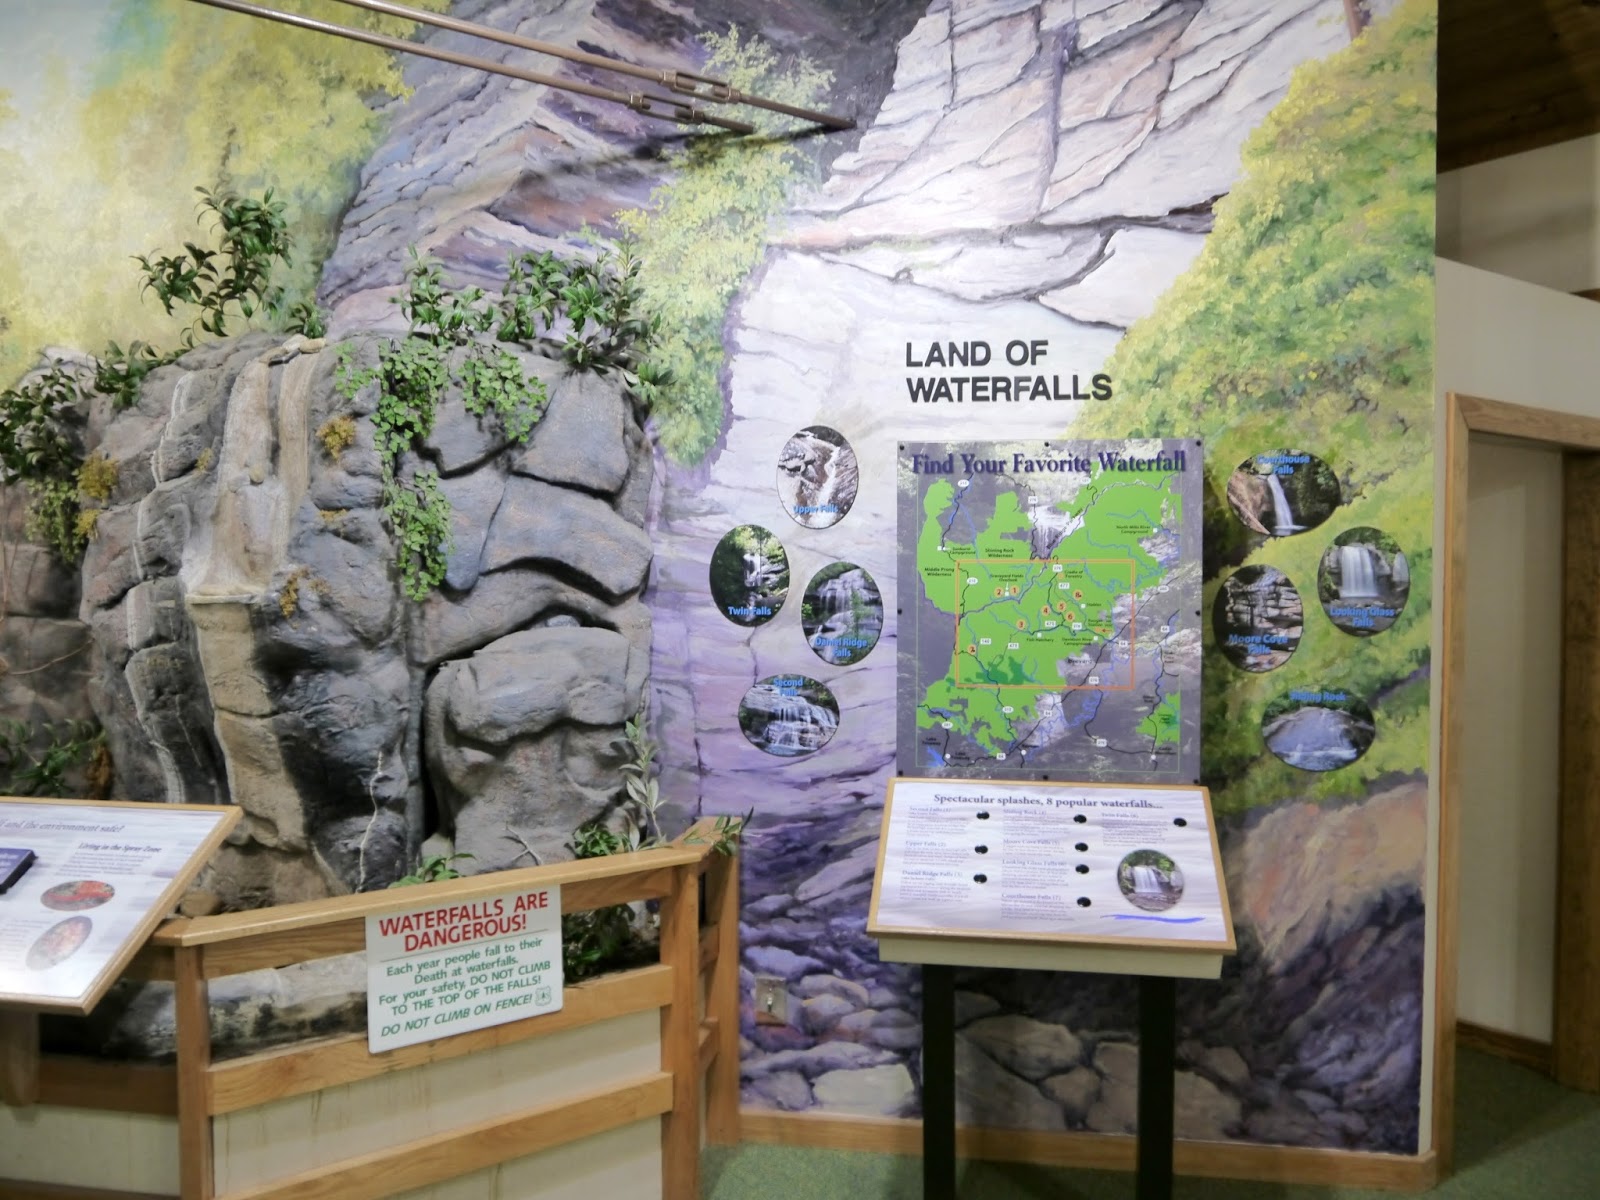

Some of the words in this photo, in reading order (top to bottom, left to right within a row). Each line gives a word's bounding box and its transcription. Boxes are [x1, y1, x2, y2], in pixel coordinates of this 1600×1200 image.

[906, 341, 991, 367] LAND
[1006, 340, 1048, 366] OF
[906, 374, 1112, 402] WATERFALLS
[912, 453, 954, 474] Find
[960, 453, 1006, 474] Your
[1013, 452, 1091, 473] Favorite
[1098, 450, 1186, 472] Waterfall
[1257, 455, 1310, 464] Courthouse
[1273, 465, 1293, 475] Falls
[793, 505, 818, 514] Upper
[820, 504, 838, 513] Falls
[728, 607, 749, 616] Twin
[752, 606, 772, 615] Falls
[1330, 607, 1368, 617] Looking
[1370, 607, 1394, 616] Glass
[1352, 617, 1374, 626] Falls
[815, 638, 842, 646] Daniel
[843, 638, 867, 647] Ridge
[1229, 635, 1262, 644] Moore
[1263, 635, 1288, 644] Cove
[832, 649, 851, 657] Falls
[1247, 645, 1271, 654] Falls
[774, 678, 803, 687] Second
[780, 688, 798, 696] Falls
[1290, 691, 1322, 702] Sliding
[1324, 692, 1346, 701] Rock
[934, 794, 995, 805] Spectacular
[998, 796, 1044, 806] splashes,
[1056, 798, 1097, 808] popular
[1100, 800, 1164, 809] waterfalls...
[24, 821, 38, 829] the
[40, 822, 99, 832] environment
[379, 898, 504, 937] WATERFALLS
[514, 892, 548, 913] ARE
[404, 914, 526, 952] DANGEROUS!
[387, 964, 413, 977] Each
[417, 958, 442, 975] year
[445, 950, 481, 971] people
[485, 943, 501, 958] fall
[504, 942, 516, 954] to
[520, 937, 543, 951] their
[414, 969, 448, 985] Death
[452, 967, 462, 976] at
[467, 955, 519, 974] waterfalls.
[379, 993, 398, 1006] For
[403, 988, 427, 1003] your
[432, 979, 466, 994] safety,
[470, 974, 488, 987] DO
[492, 968, 514, 982] NOT
[518, 960, 551, 976] CLIMB
[392, 1005, 408, 1017] TO
[414, 999, 434, 1011] THE
[439, 994, 460, 1007] TOP
[464, 989, 480, 1001] OF
[484, 984, 504, 996] THE
[507, 976, 541, 991] FALLS!
[381, 1024, 401, 1038] DO
[404, 1017, 430, 1032] NOT
[434, 1008, 470, 1026] CLIMB
[474, 1004, 491, 1016] ON
[496, 994, 533, 1011] FENCE!
